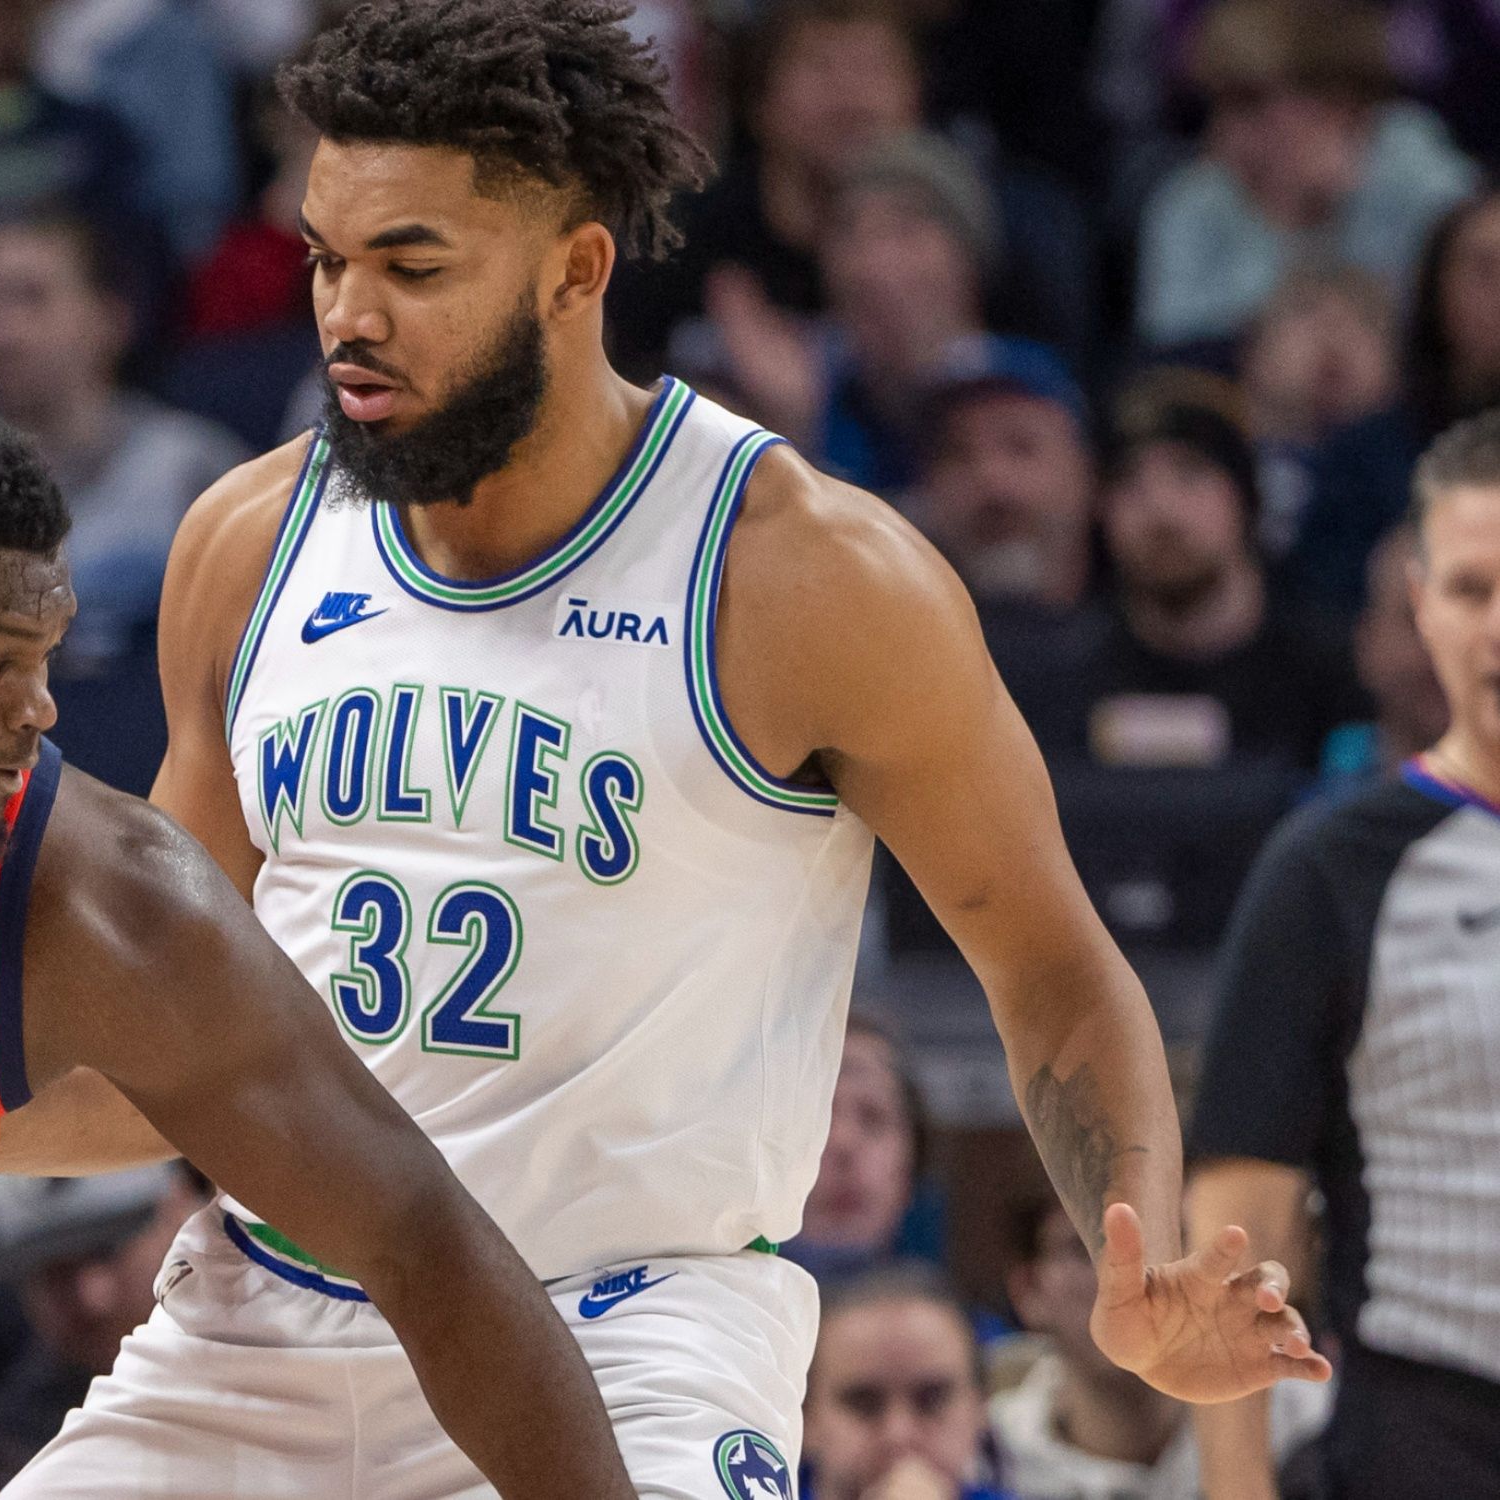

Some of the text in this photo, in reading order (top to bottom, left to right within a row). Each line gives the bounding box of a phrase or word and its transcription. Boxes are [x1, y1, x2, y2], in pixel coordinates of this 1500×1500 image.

[314, 592, 372, 620] NIKE
[258, 684, 644, 886] WOLVES
[330, 870, 523, 1061] 32
[591, 1265, 648, 1297] NIKE
